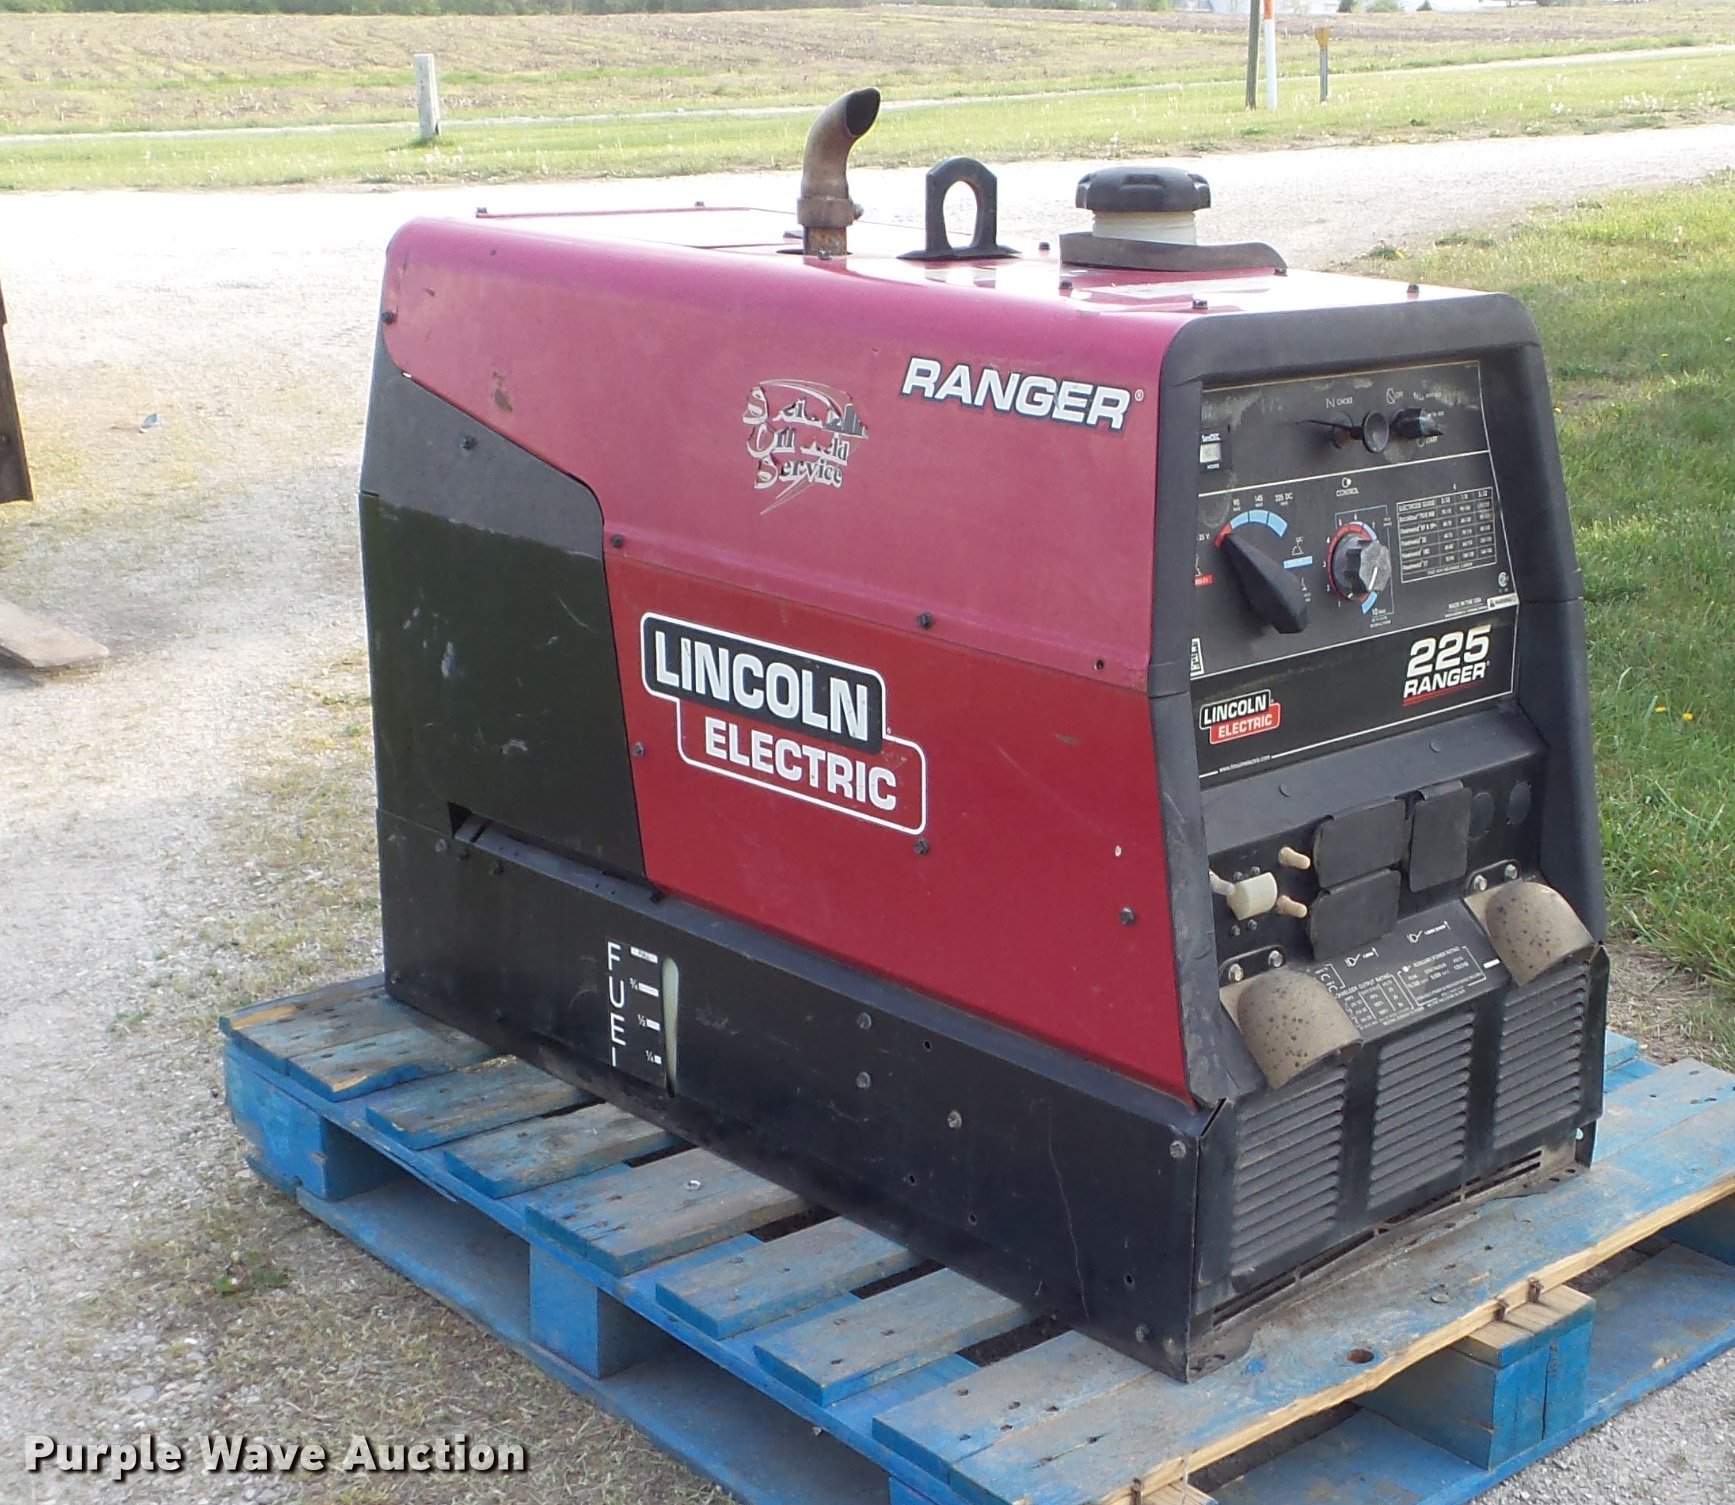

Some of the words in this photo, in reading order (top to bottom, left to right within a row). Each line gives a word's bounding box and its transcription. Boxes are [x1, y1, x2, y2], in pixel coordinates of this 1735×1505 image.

[902, 357, 1131, 430] RANGER
[754, 455, 843, 489] Service
[1336, 487, 1359, 497] CONTROL
[1406, 624, 1492, 677] 225
[655, 630, 868, 742] LINCOLN
[1403, 664, 1487, 699] RANGER
[1203, 694, 1267, 725] LINCOLN
[1218, 713, 1273, 739] ELECTRIC
[705, 716, 896, 811] ELECTRIC
